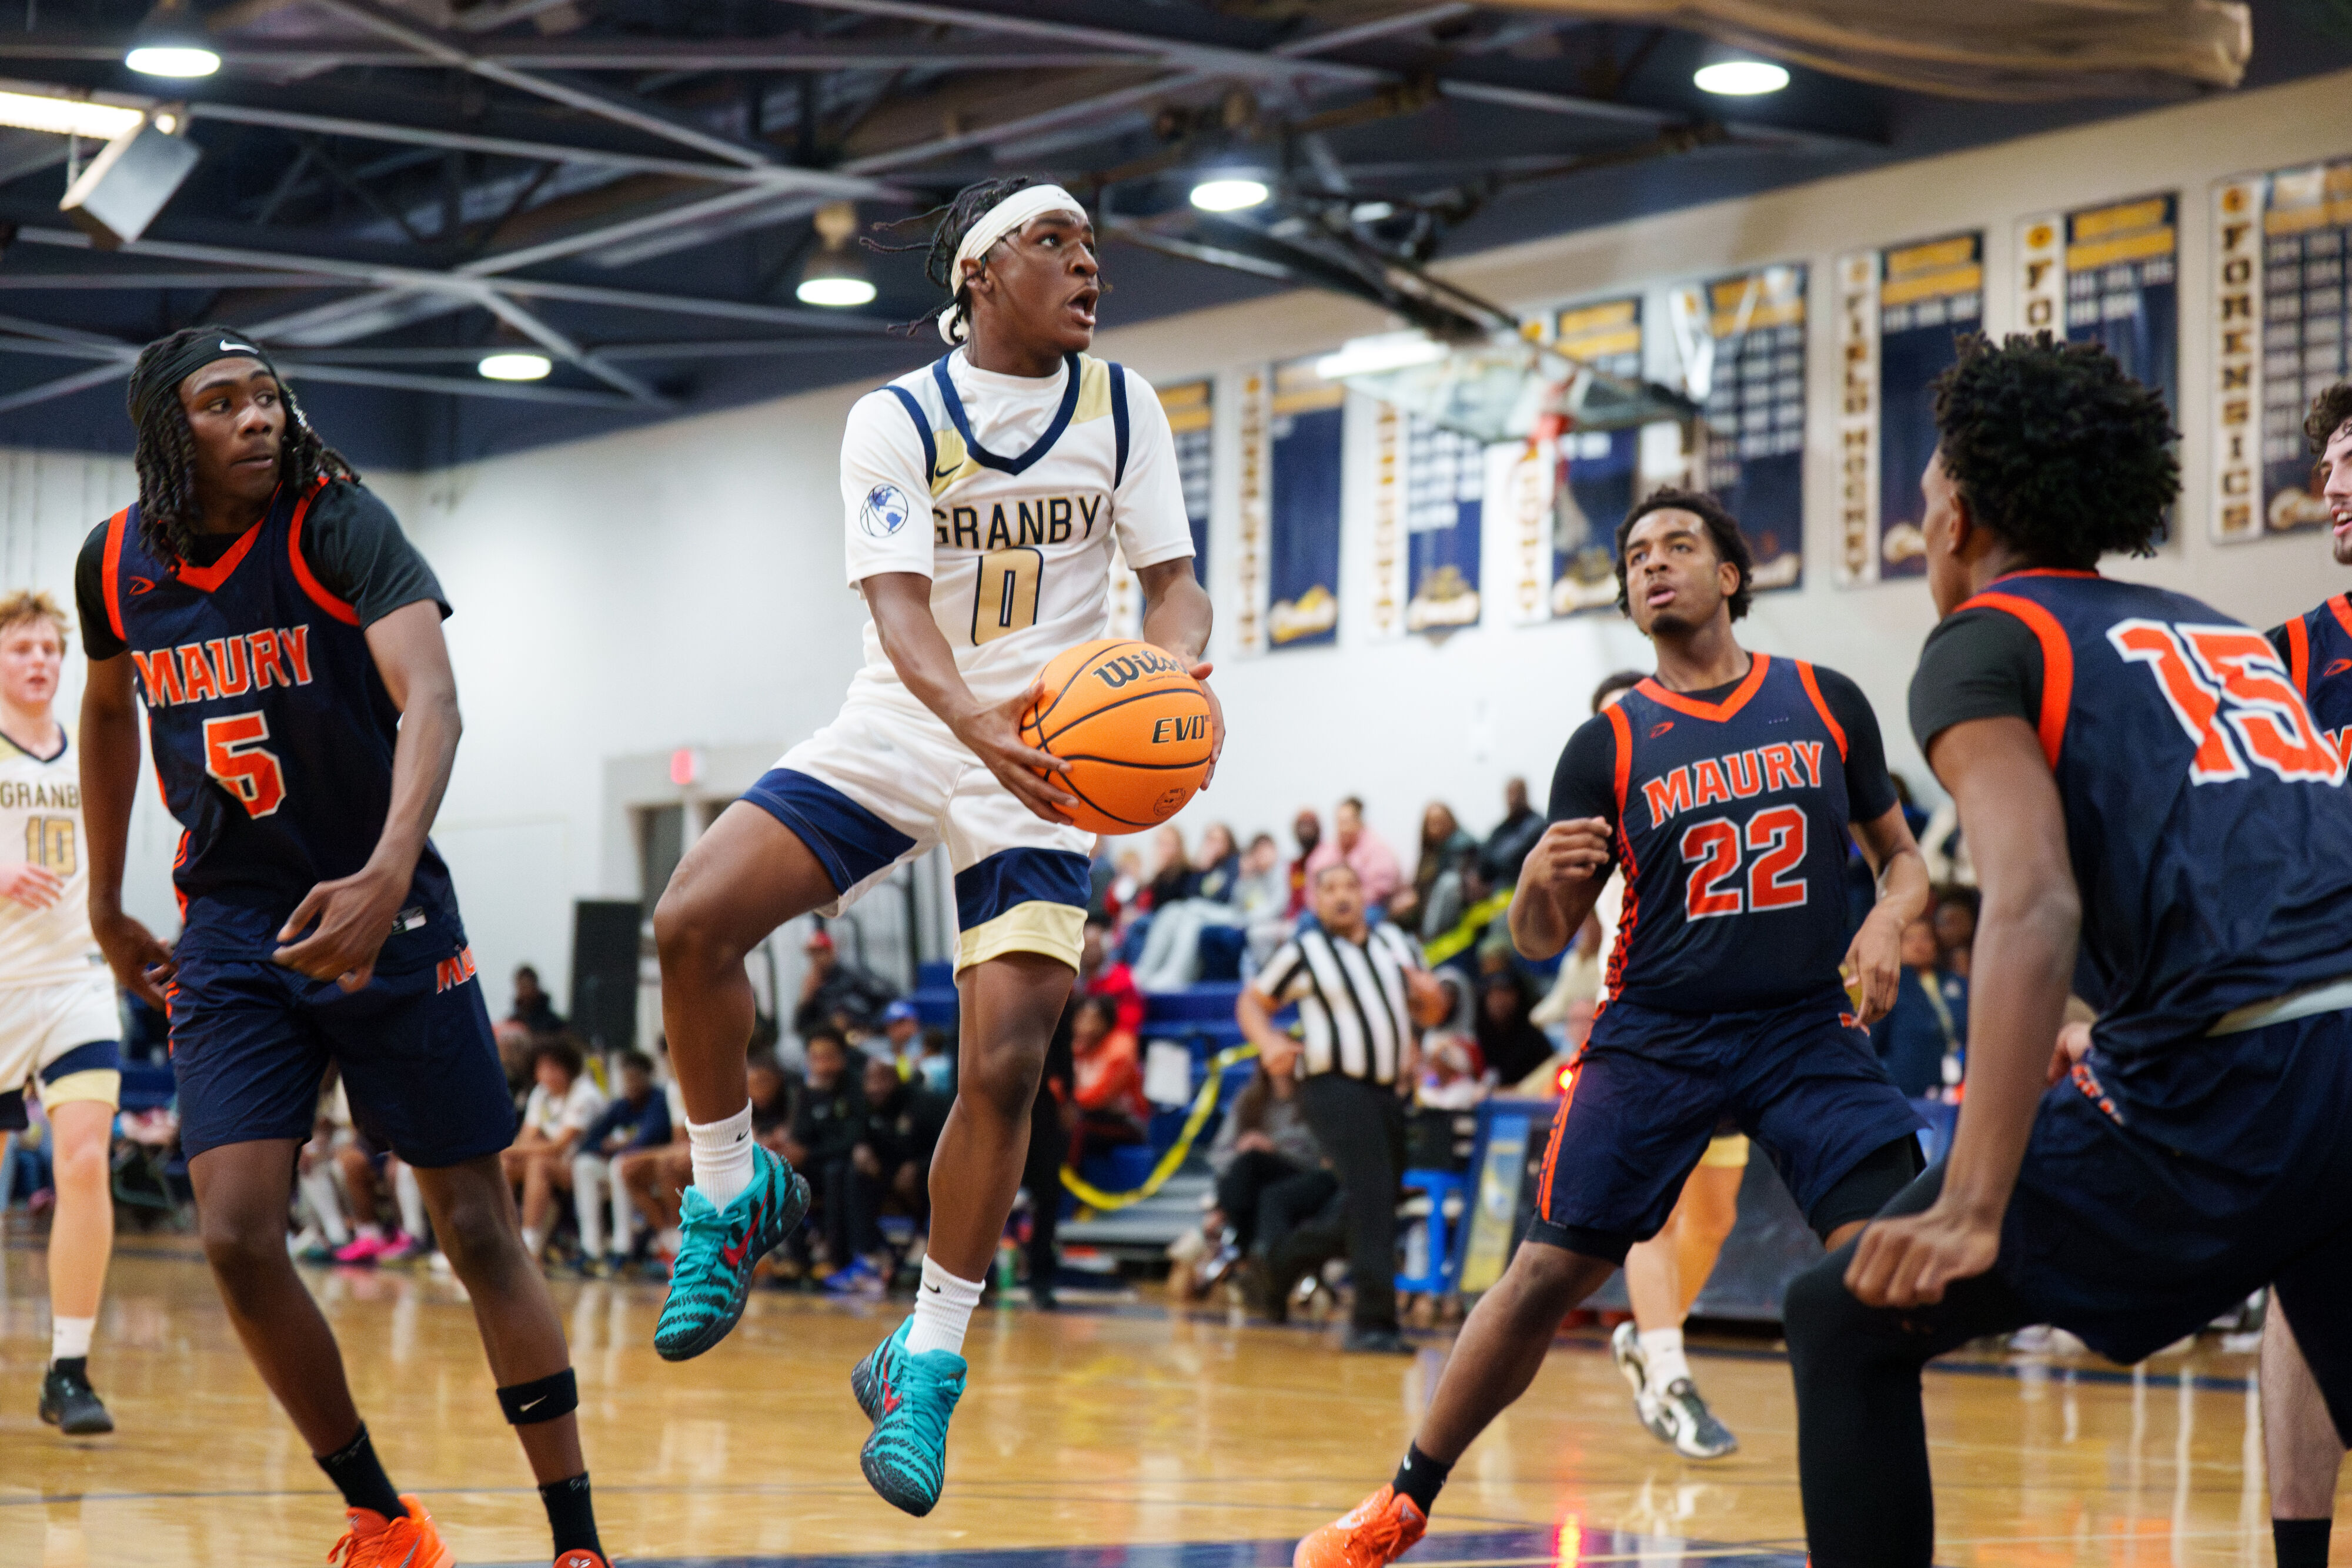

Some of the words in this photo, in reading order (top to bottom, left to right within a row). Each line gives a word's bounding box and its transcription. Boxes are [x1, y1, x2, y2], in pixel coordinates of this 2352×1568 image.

[131, 623, 313, 708] MAURY
[2105, 617, 2346, 787] 15
[0, 781, 81, 808] GRANB
[202, 709, 287, 820] 5
[1641, 740, 1823, 830] MAURY
[25, 815, 76, 877] 10
[1679, 804, 1808, 923] 22
